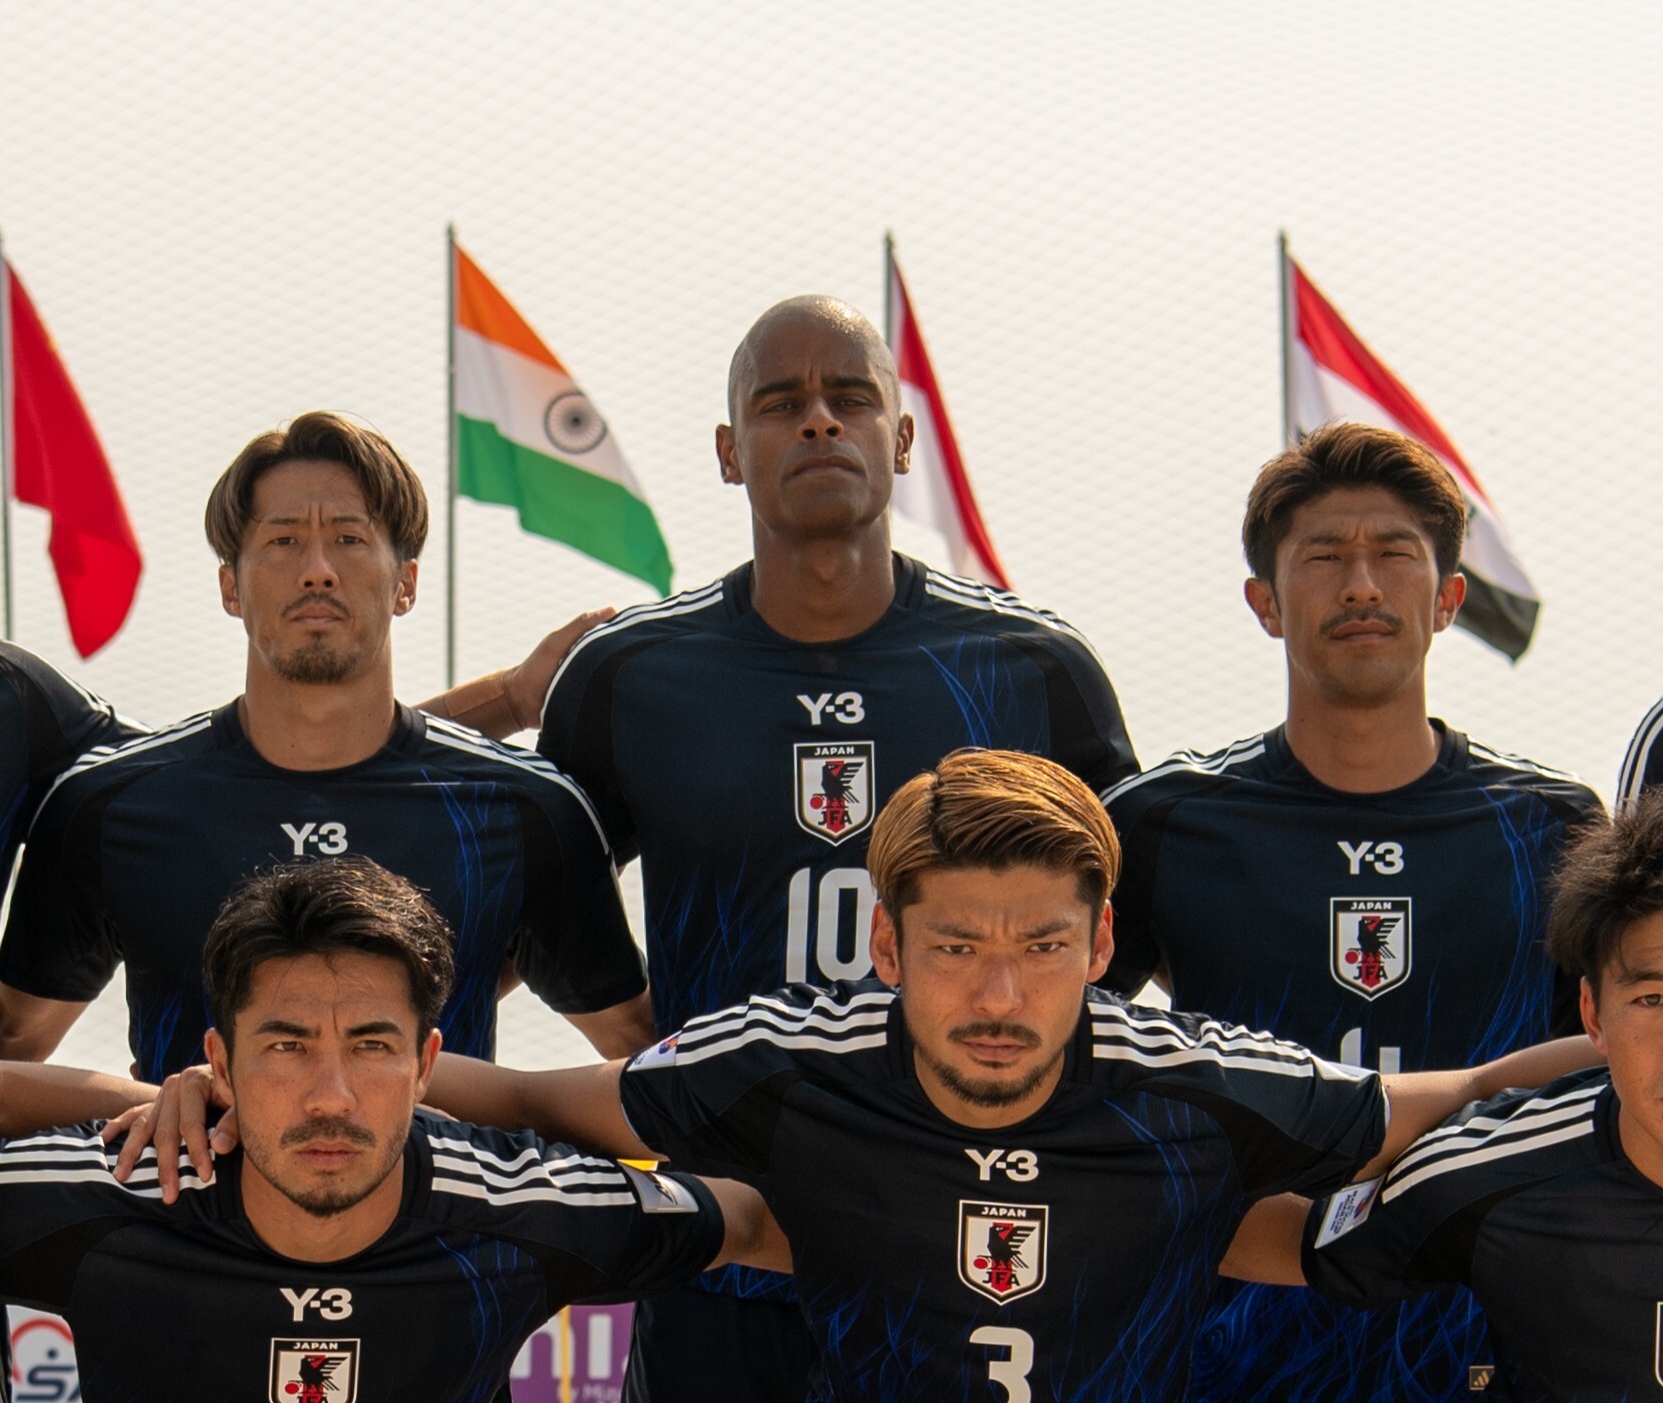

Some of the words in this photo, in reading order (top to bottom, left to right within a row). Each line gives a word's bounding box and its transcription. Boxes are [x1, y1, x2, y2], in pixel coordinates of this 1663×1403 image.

[797, 692, 866, 725] Y-3
[813, 745, 856, 756] JAPAN
[817, 809, 854, 826] JFA
[281, 822, 348, 855] Y-3
[1338, 841, 1404, 874] Y-3
[1350, 901, 1392, 912] JAPAN
[786, 867, 877, 982] 10
[1352, 965, 1389, 981] JFA
[965, 1149, 1039, 1182] Y-3
[981, 1206, 1027, 1218] JAPAN
[982, 1270, 1020, 1288] JFA
[280, 1287, 353, 1322] Y-3
[293, 1341, 339, 1351] JAPAN
